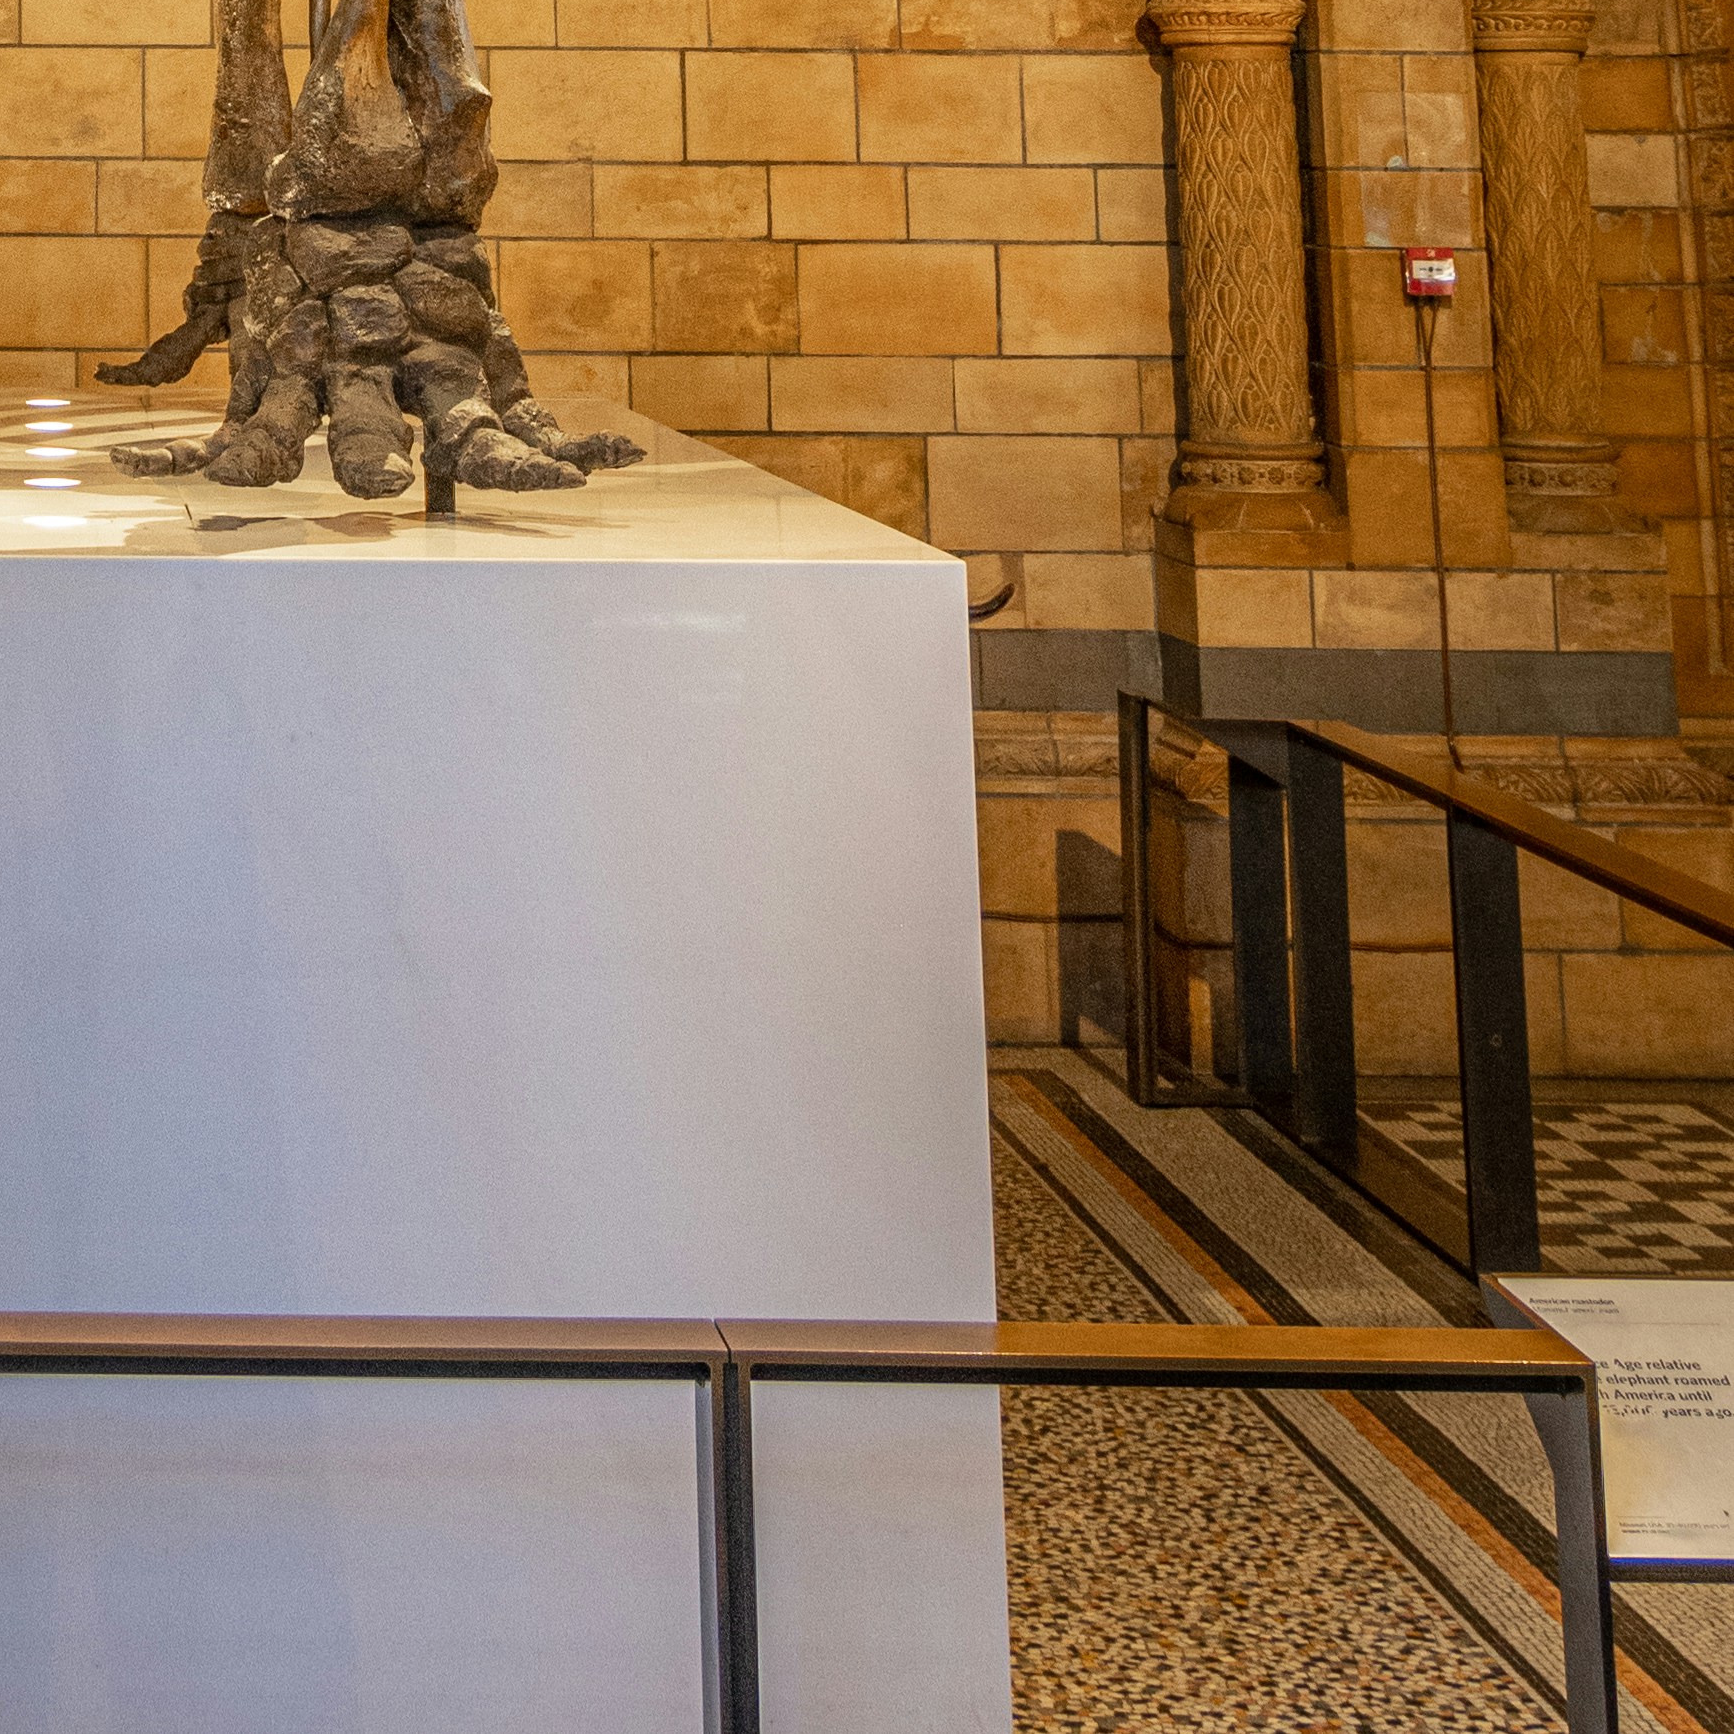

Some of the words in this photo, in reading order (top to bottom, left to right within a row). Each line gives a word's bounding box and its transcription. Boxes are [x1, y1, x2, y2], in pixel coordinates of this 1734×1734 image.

[1613, 1358, 1644, 1372] Age
[1646, 1359, 1702, 1371] relative
[1605, 1374, 1670, 1387] elephant
[1674, 1375, 1731, 1387] roamed
[1614, 1389, 1676, 1401] America
[1678, 1390, 1713, 1402] until
[1662, 1406, 1702, 1419] years
